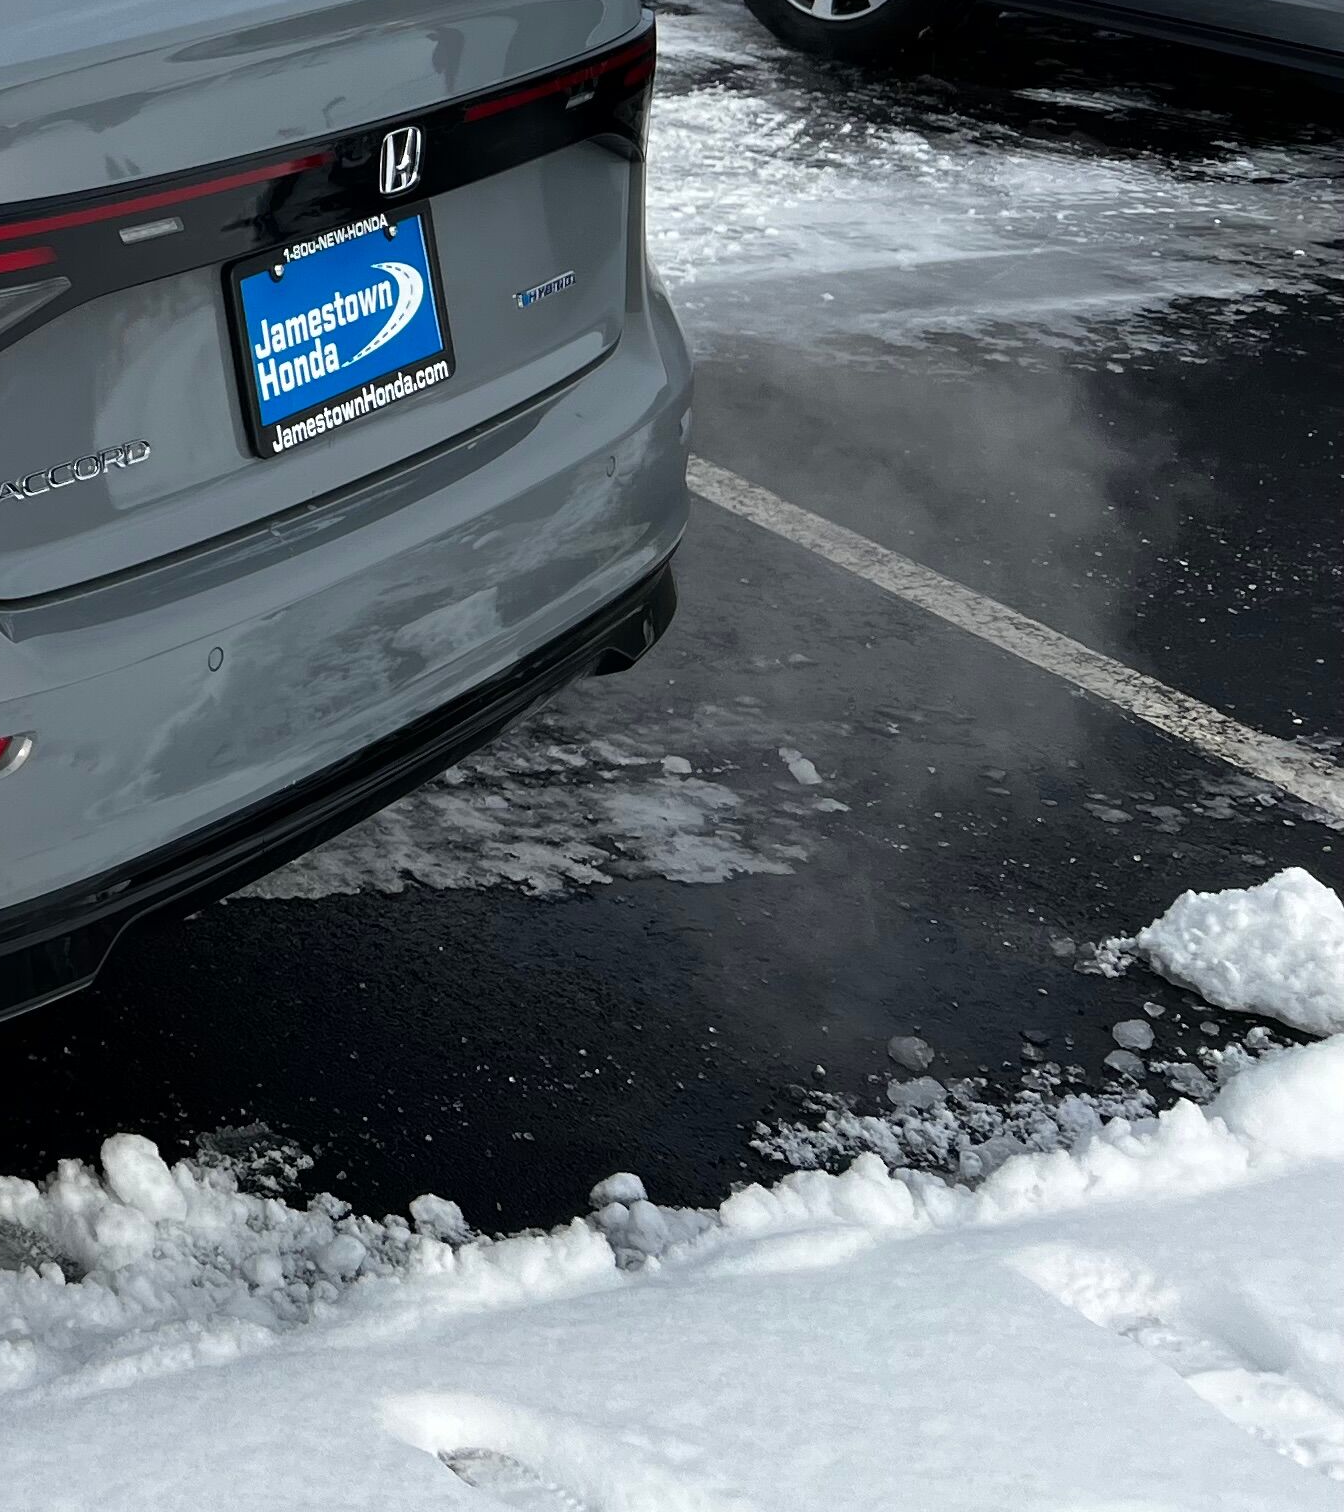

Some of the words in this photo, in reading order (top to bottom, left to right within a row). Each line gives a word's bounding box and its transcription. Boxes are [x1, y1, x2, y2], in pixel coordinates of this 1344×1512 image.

[283, 213, 389, 263] 1-800-NEW-HONDA
[254, 279, 394, 359] Jamestown
[257, 337, 341, 401] Honda
[272, 359, 450, 453] JamestownHonda.com
